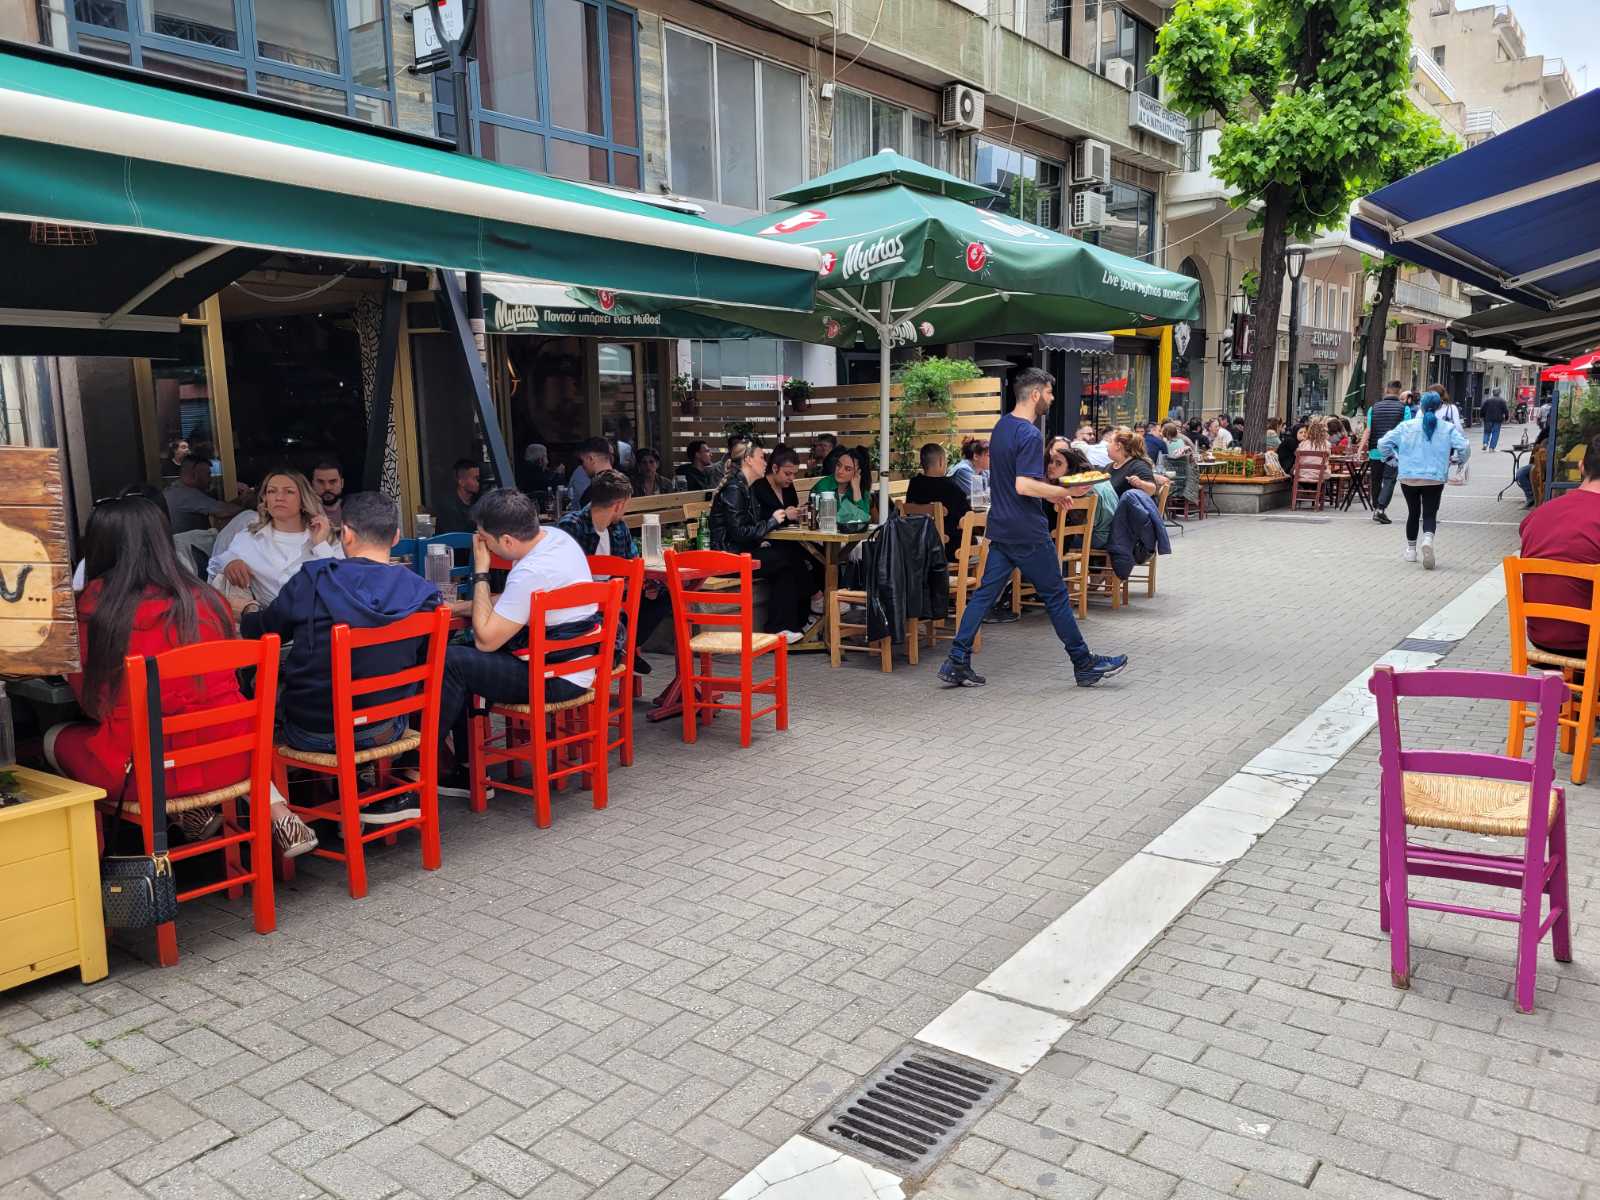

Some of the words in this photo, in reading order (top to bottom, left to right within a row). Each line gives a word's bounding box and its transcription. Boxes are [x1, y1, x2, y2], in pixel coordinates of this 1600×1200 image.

[842, 233, 906, 281] Mythos
[1102, 270, 1119, 286] Live
[1120, 279, 1136, 291] your
[495, 300, 539, 332] Mythos
[543, 309, 576, 323] Παντού
[578, 311, 611, 326] υπάρχει
[633, 313, 661, 326] Μύθος!
